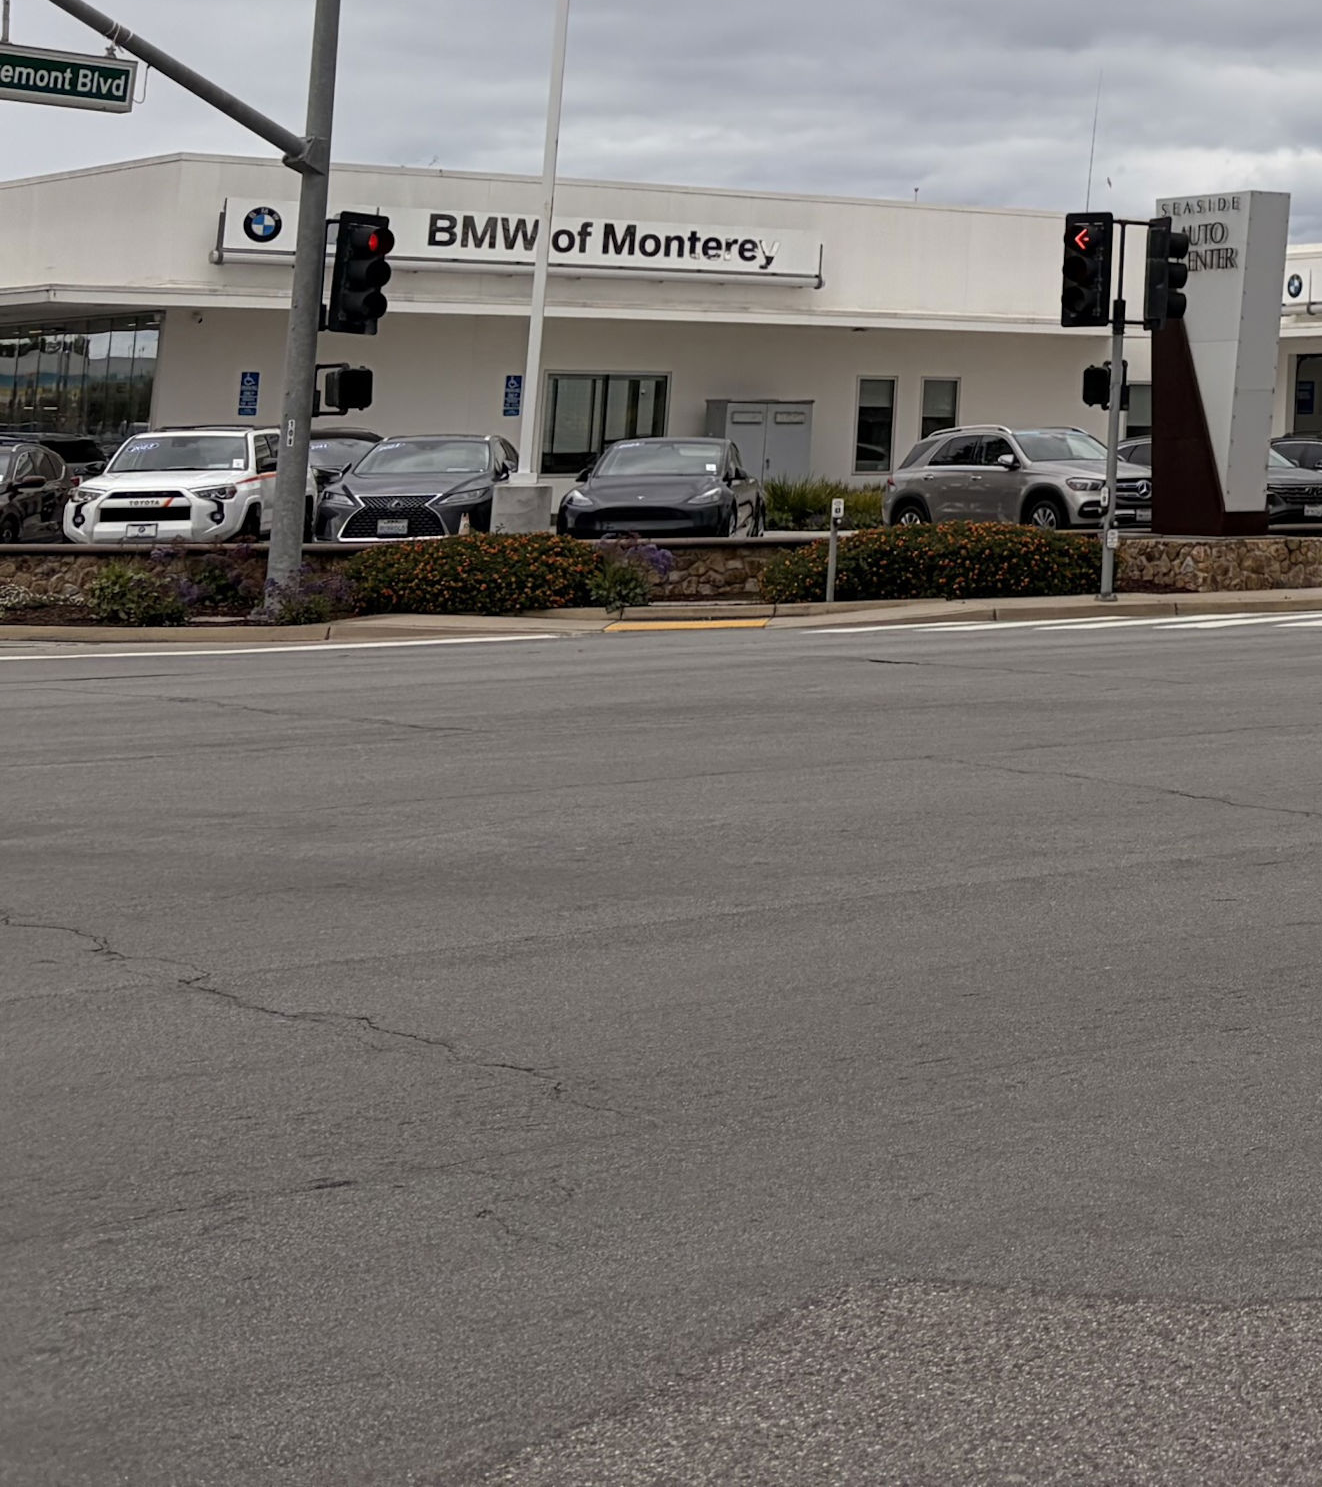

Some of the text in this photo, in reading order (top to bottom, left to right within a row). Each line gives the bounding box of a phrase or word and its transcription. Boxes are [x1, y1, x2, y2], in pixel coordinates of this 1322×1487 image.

[0, 64, 126, 96] emont Blvd
[1161, 196, 1240, 217] SEASIDE
[427, 213, 781, 270] BMW of Monterey
[1187, 247, 1236, 272] ENTER
